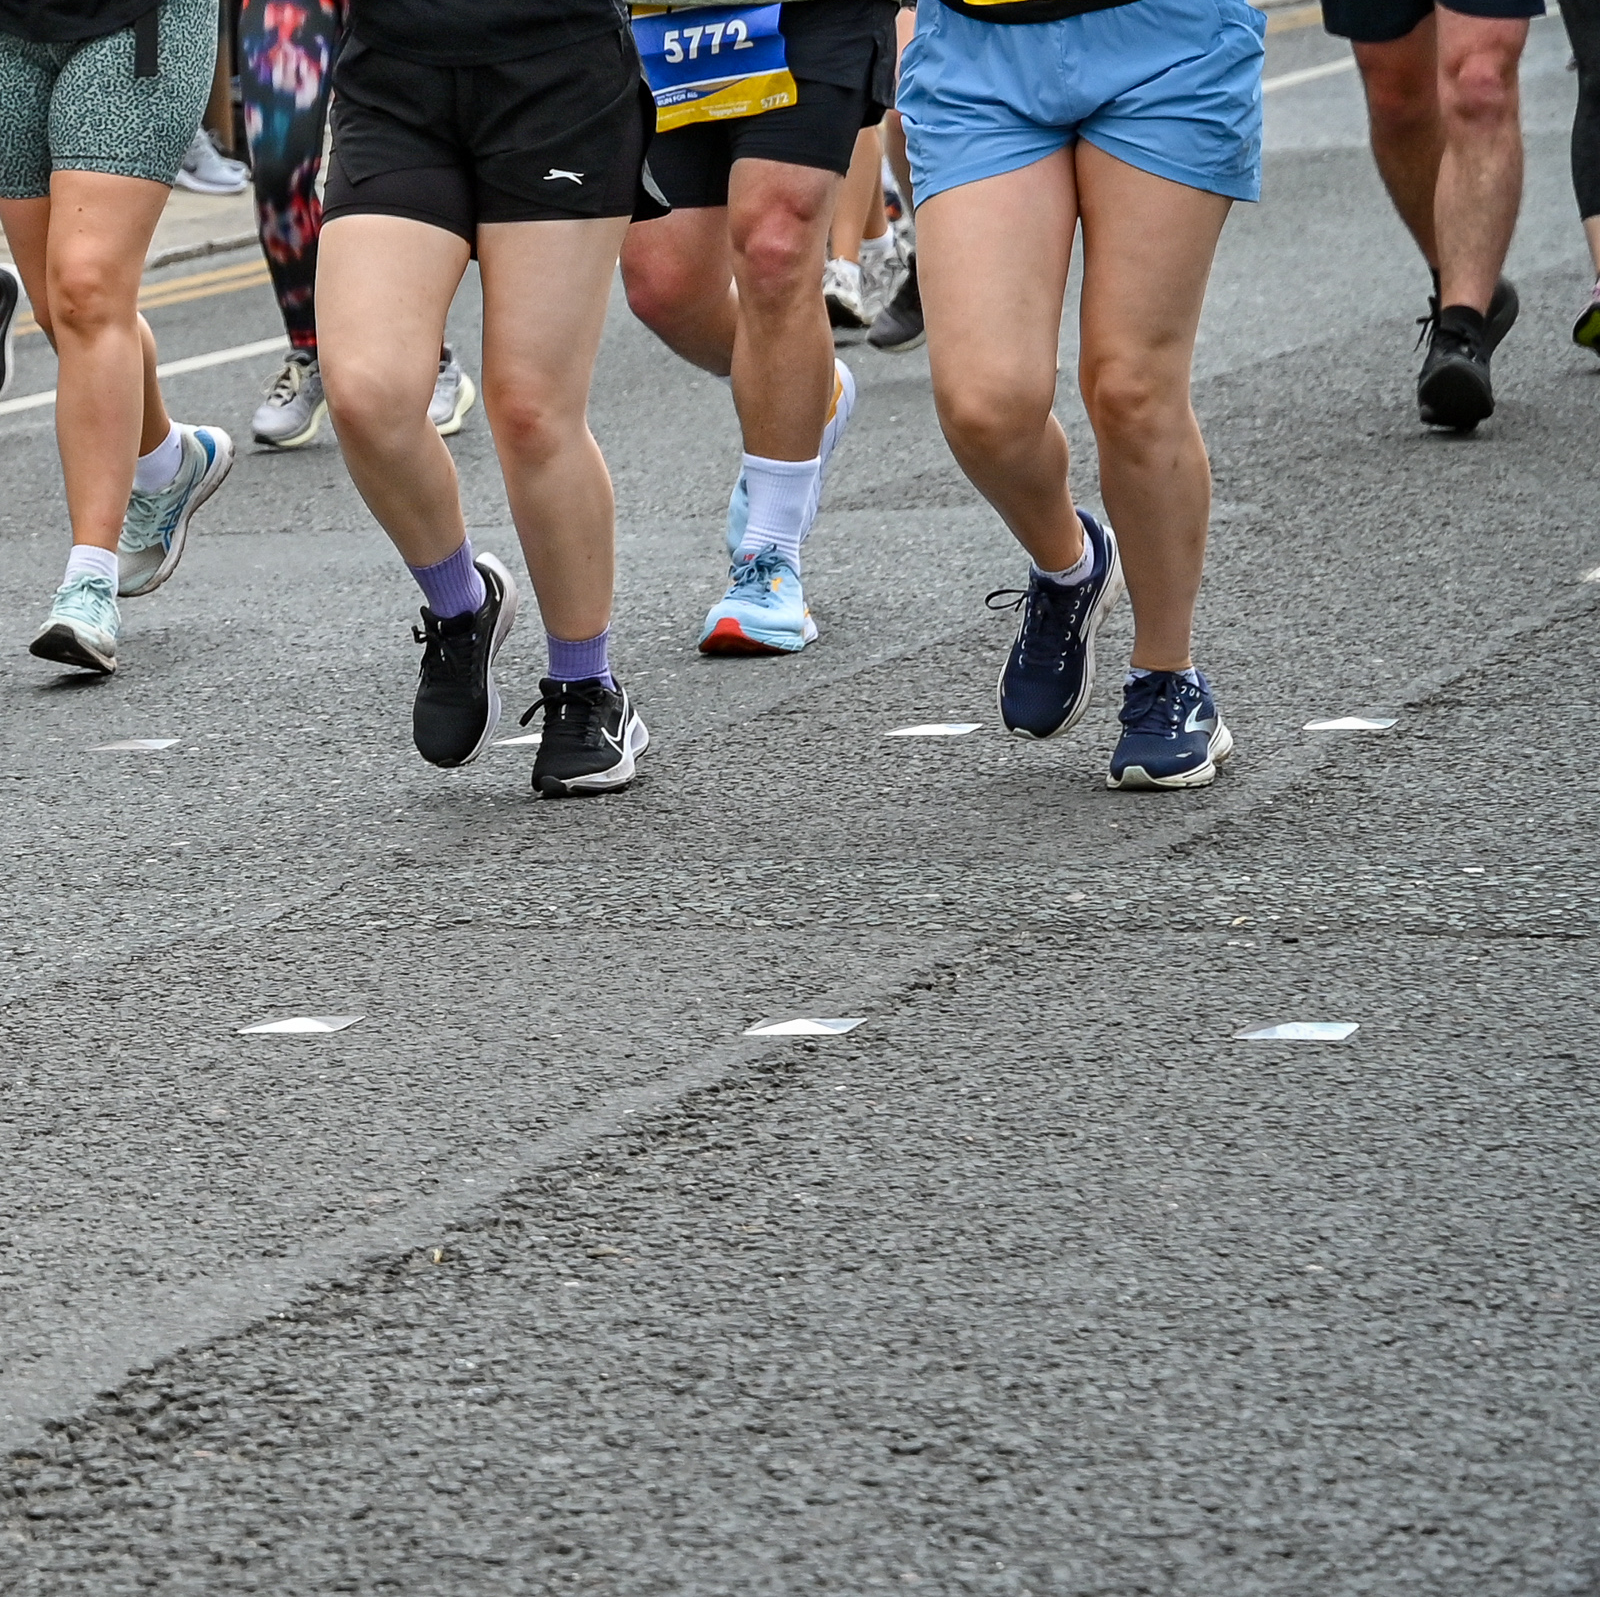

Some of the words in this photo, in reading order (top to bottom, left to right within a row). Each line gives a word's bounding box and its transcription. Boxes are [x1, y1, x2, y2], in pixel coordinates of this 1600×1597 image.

[664, 19, 754, 63] 5772
[673, 93, 686, 103] FOR
[760, 92, 789, 109] 5772
